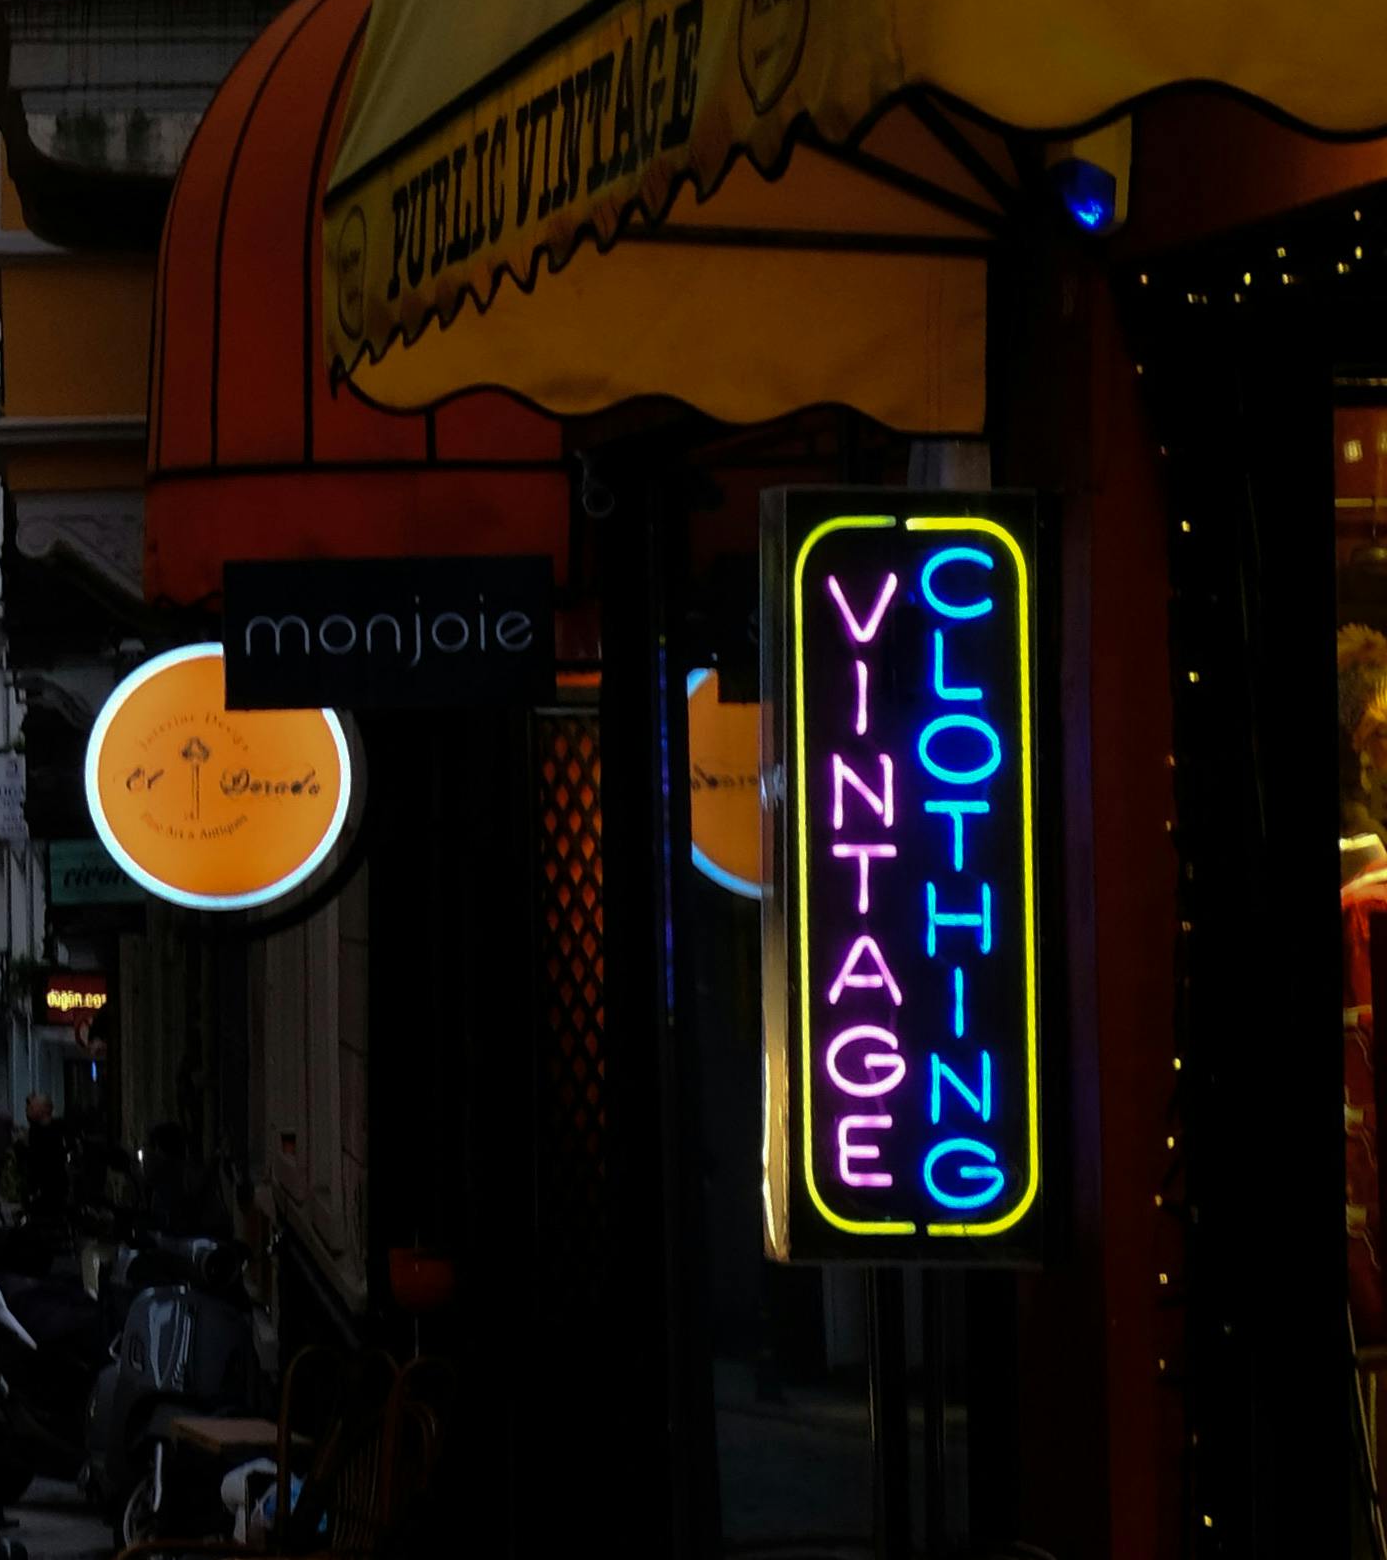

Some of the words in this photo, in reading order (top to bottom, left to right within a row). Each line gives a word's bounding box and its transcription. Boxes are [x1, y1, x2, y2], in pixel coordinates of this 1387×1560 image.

[387, 117, 506, 301] PUBLIC
[245, 593, 534, 669] monjoie
[827, 572, 906, 1188] VINTAGE
[918, 545, 1006, 1210] CLOTHING
